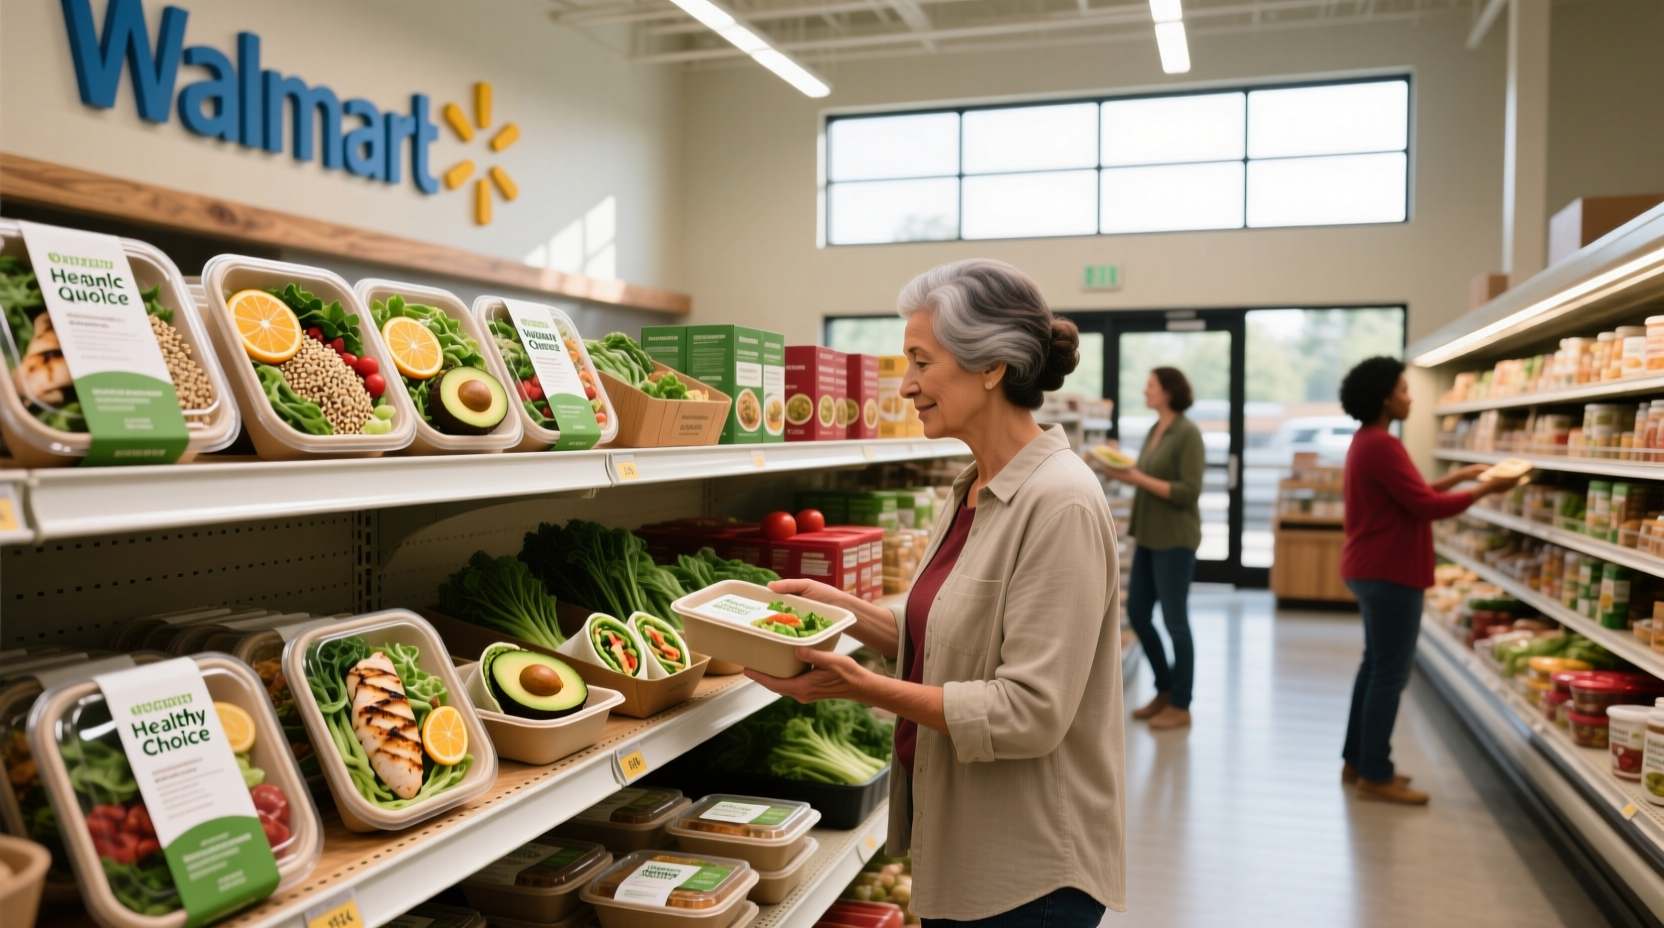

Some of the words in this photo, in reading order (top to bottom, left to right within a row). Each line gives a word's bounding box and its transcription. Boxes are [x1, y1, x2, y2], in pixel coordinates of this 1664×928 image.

[60, 0, 438, 194] Walmart
[131, 708, 205, 739] Healthy
[142, 729, 211, 756] Choice
